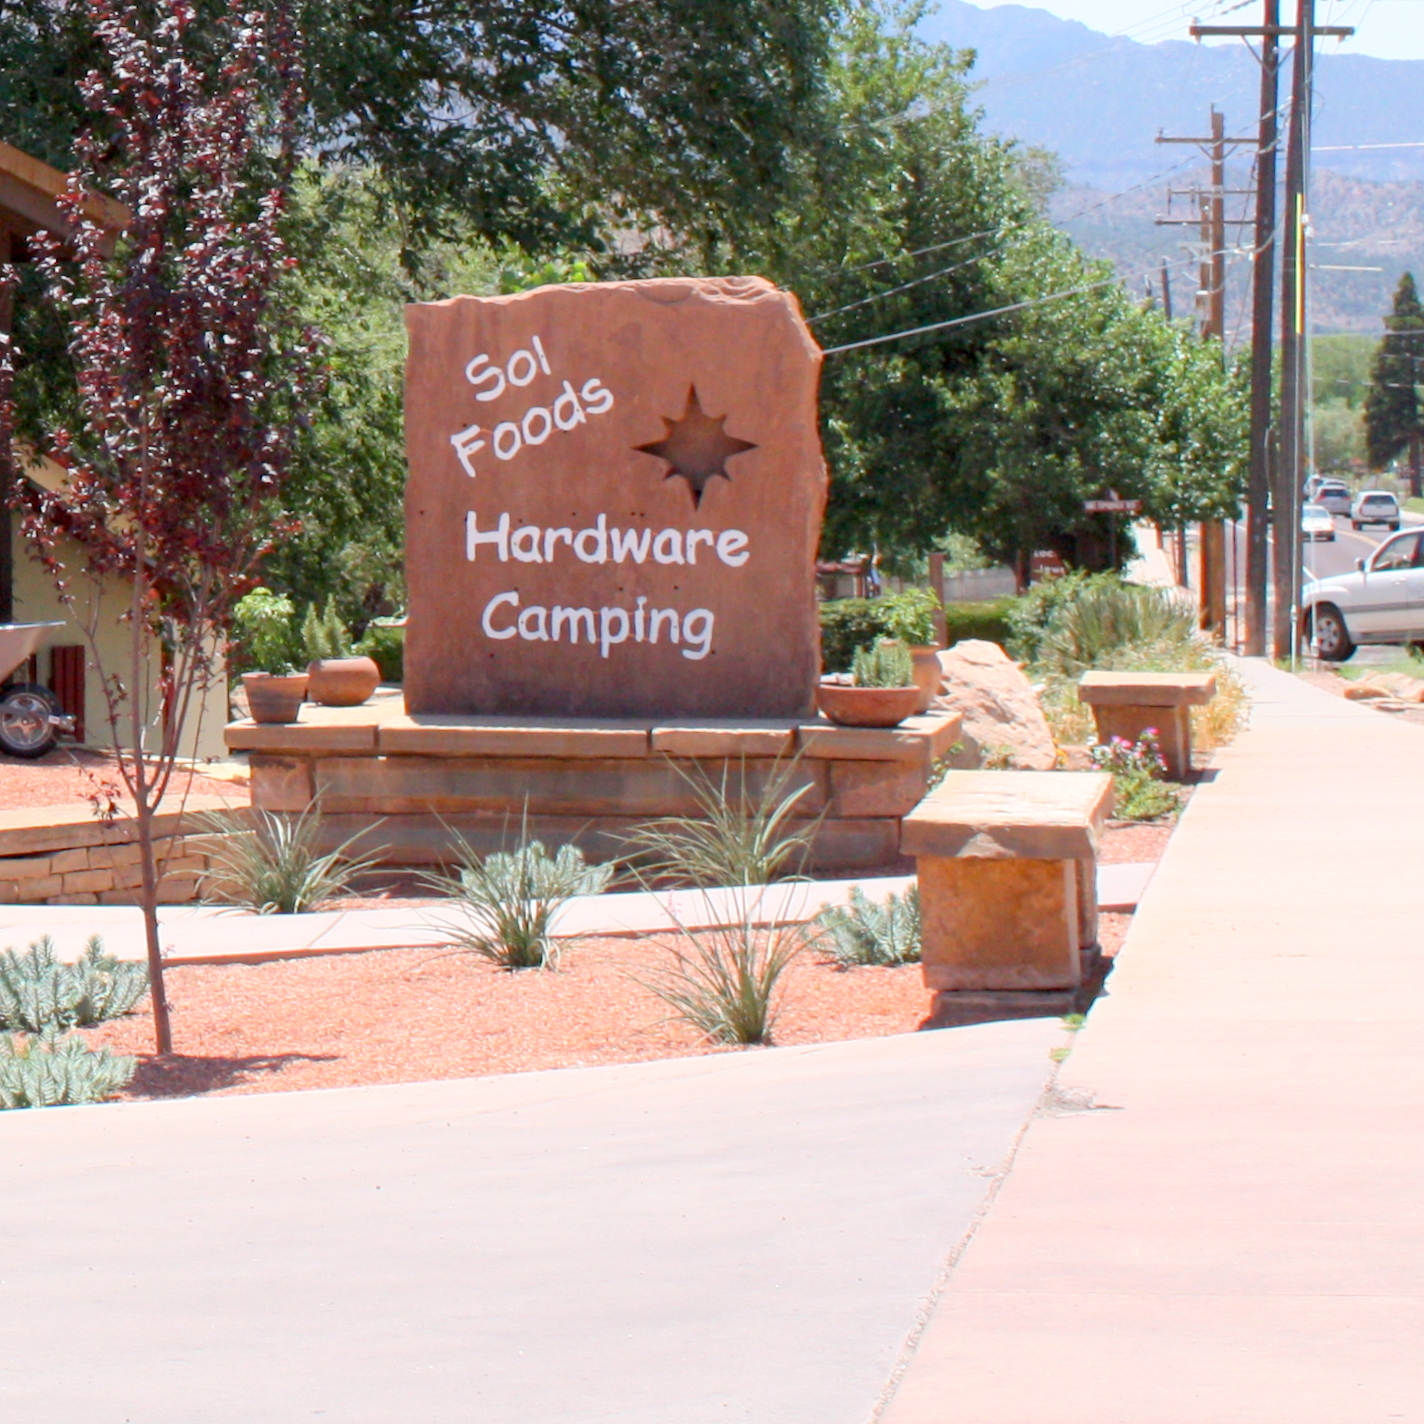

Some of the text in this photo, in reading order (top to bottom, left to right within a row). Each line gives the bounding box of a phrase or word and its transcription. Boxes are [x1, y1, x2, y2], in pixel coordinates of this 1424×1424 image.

[465, 335, 552, 402] Sol
[450, 377, 615, 478] Foods
[465, 510, 751, 568] Hardware
[482, 590, 715, 661] Camping
